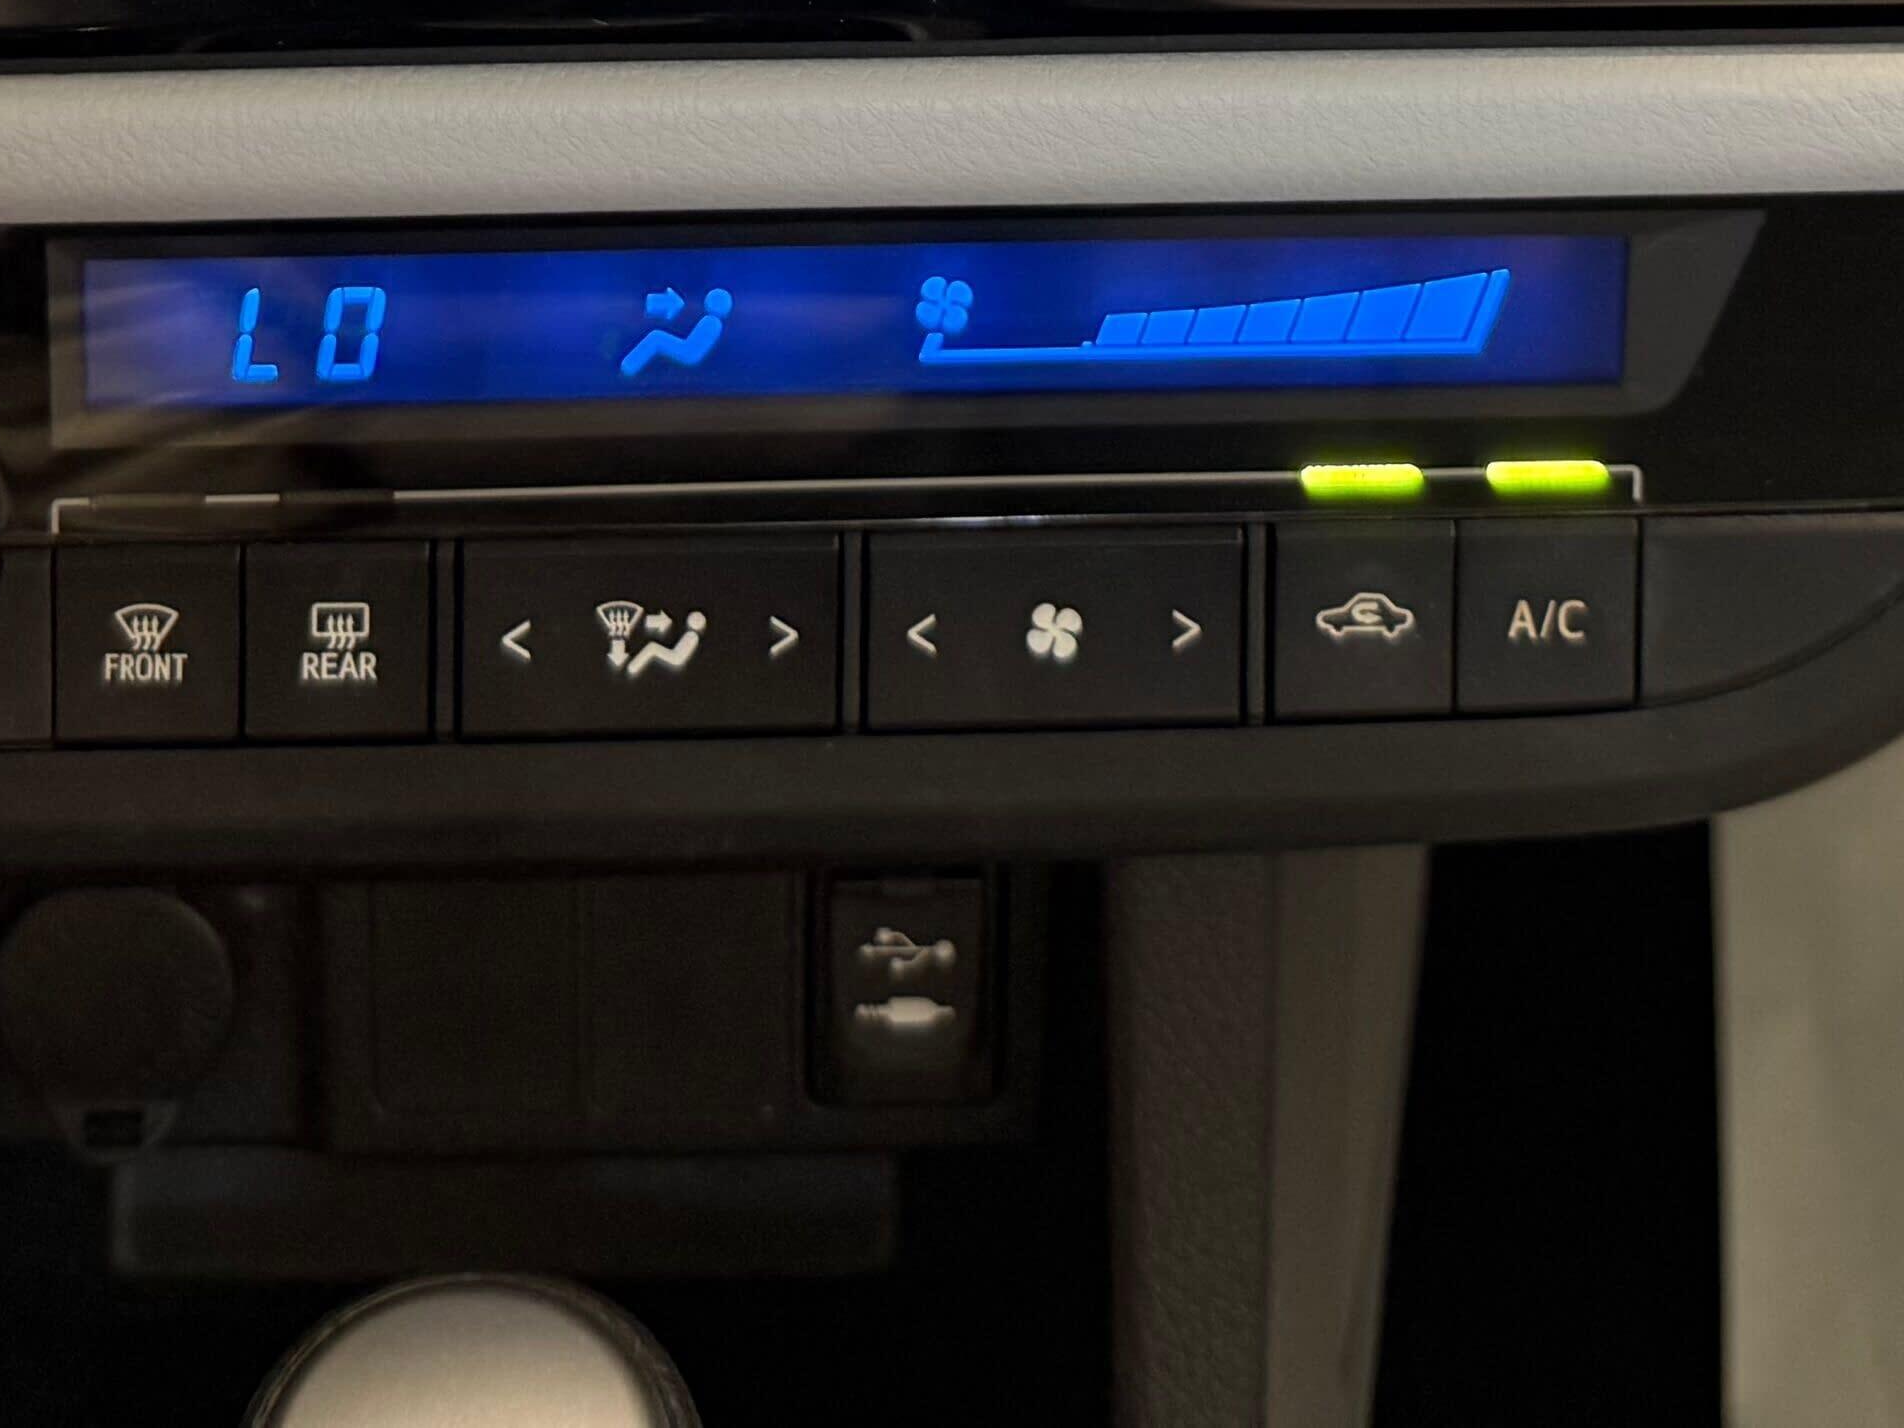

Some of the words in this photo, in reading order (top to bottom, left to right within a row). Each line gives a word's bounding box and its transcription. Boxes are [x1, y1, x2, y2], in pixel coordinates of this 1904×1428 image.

[1508, 599, 1586, 645] A/C
[104, 652, 188, 682] FRONT
[301, 650, 378, 682] REAR
